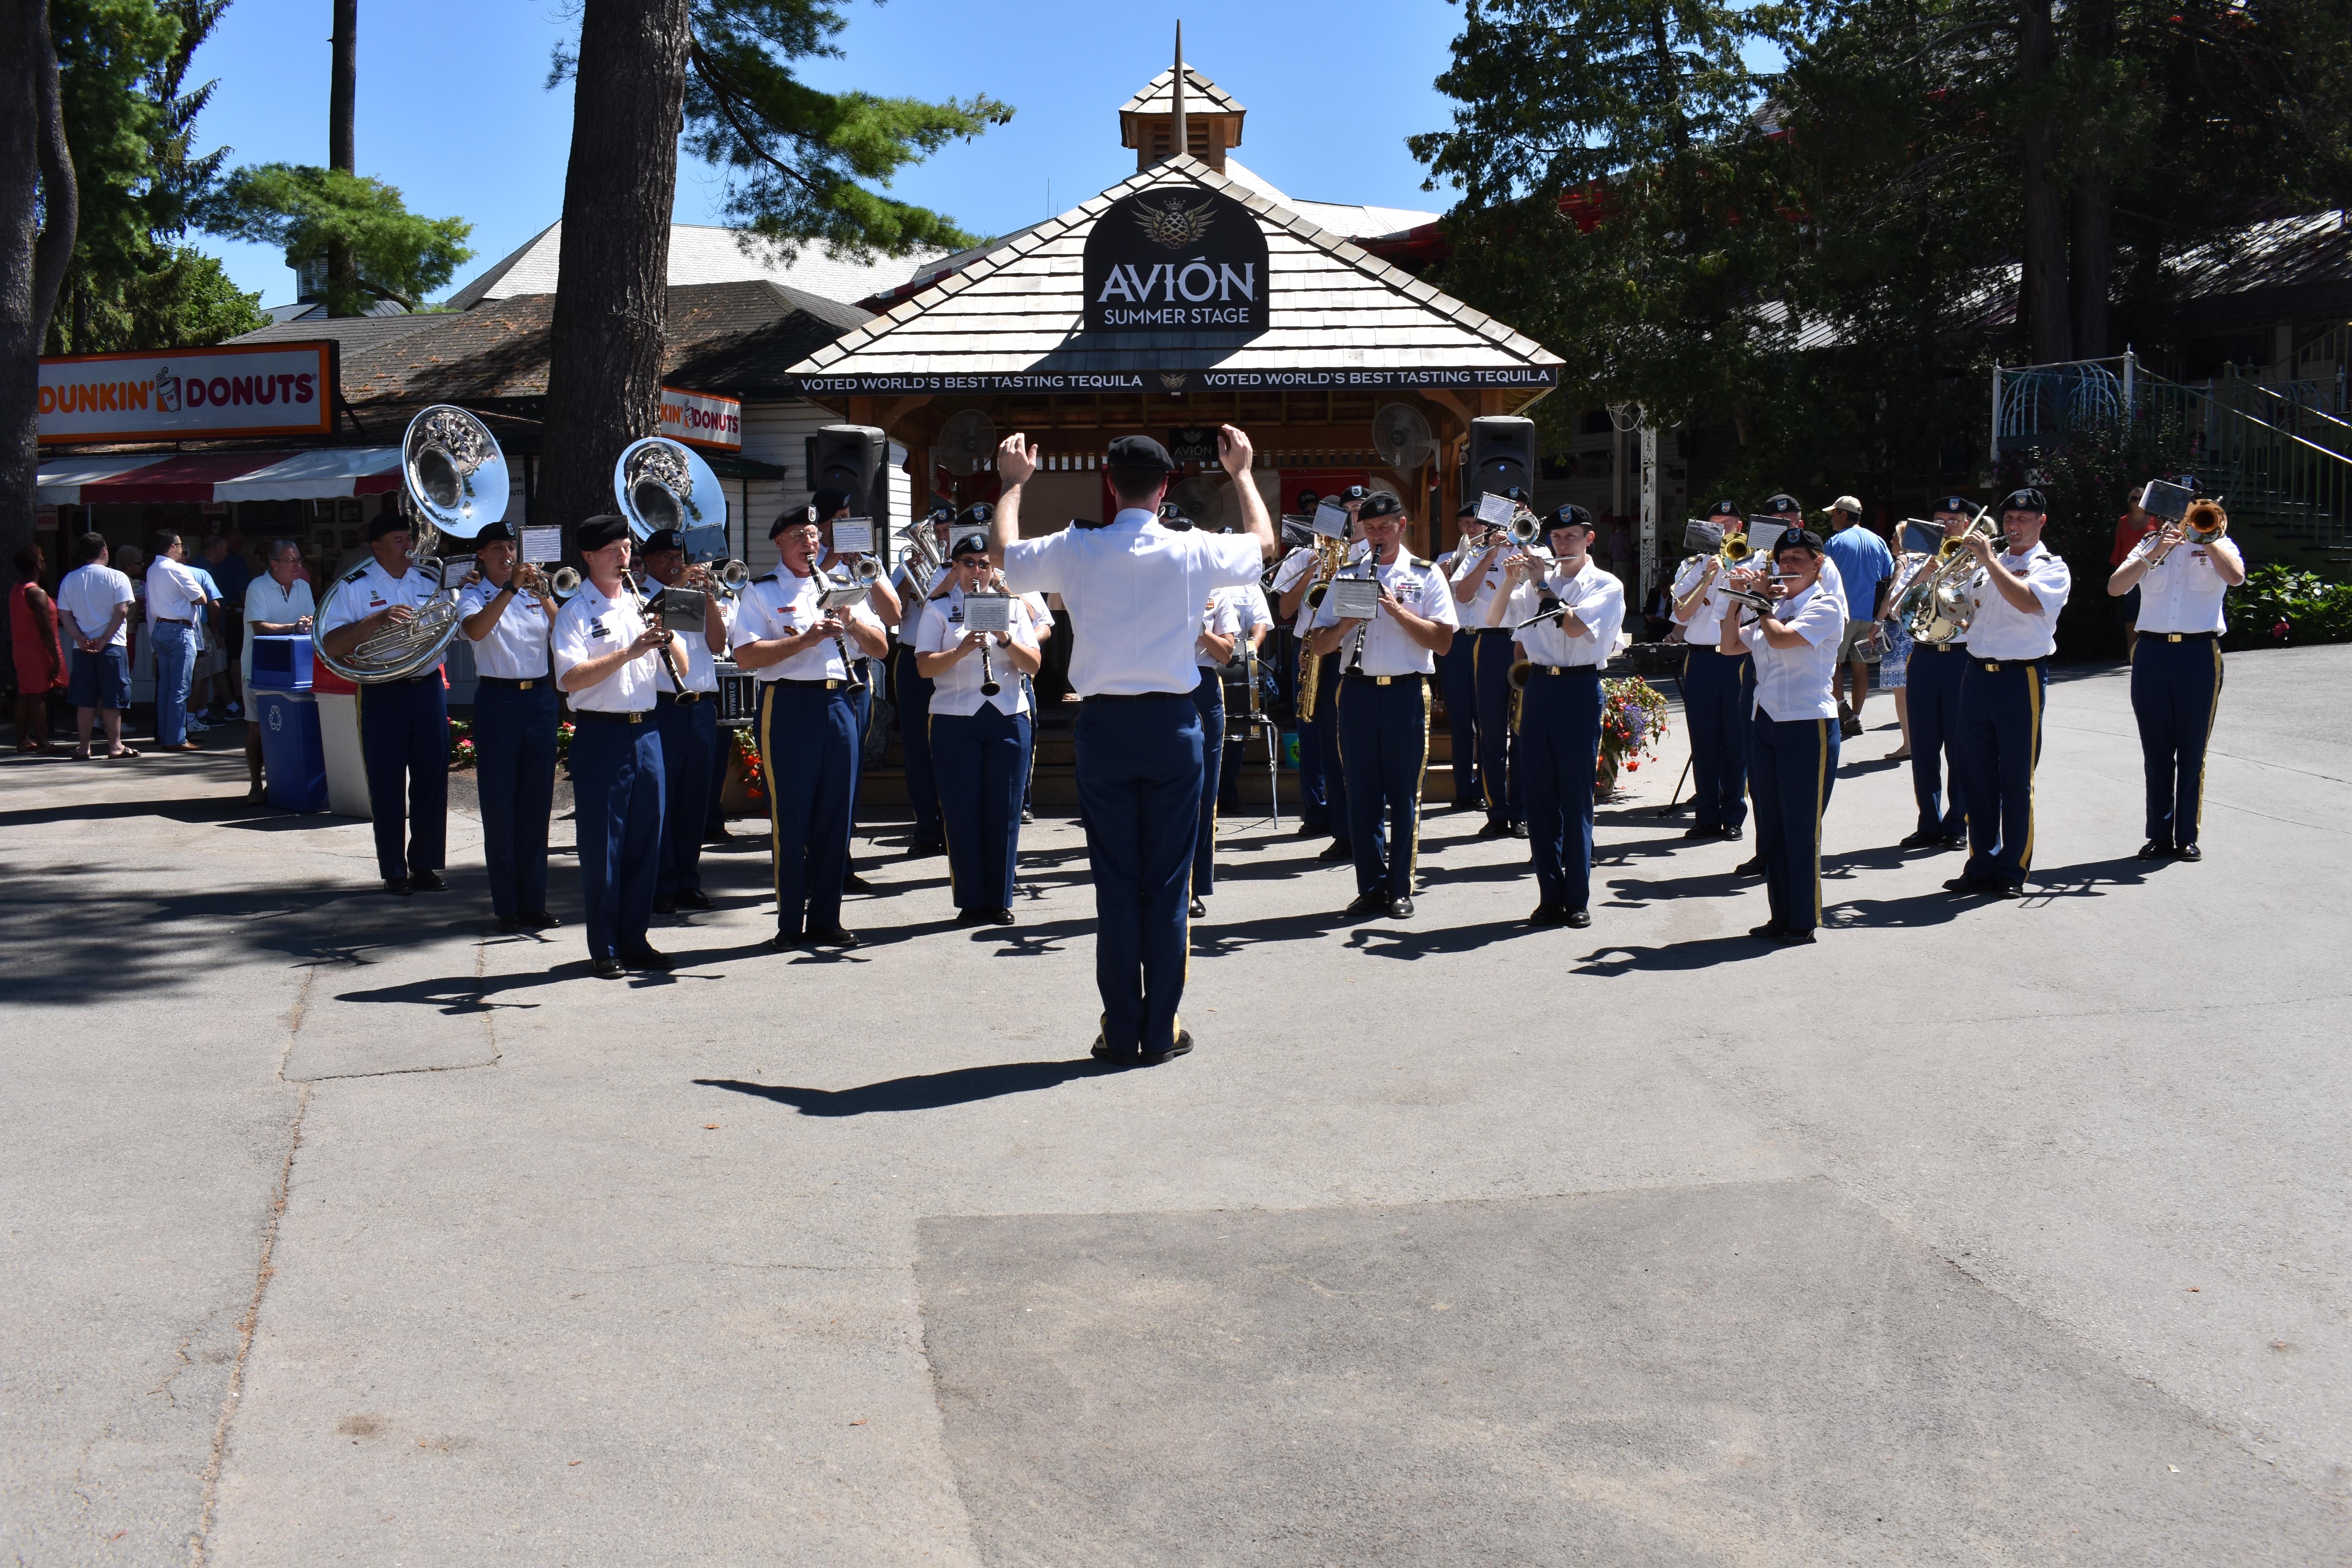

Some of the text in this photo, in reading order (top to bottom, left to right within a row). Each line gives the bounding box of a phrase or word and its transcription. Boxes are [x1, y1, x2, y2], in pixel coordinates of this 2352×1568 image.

[1096, 256, 1256, 303] AVIÓN
[1104, 308, 1249, 325] SUMMER STAGE
[800, 375, 1143, 390] VOTED WORLD'S BEST TASTING TEQUILA
[1204, 370, 1550, 385] VOTED WORLD'S BEST TASTING TEQUILA
[38, 380, 154, 414] DUNKIN'
[186, 373, 314, 407] DONUTS
[693, 409, 739, 434] DONUTS
[1174, 444, 1212, 456] AVIÓN
[37, 516, 56, 525] HERE
